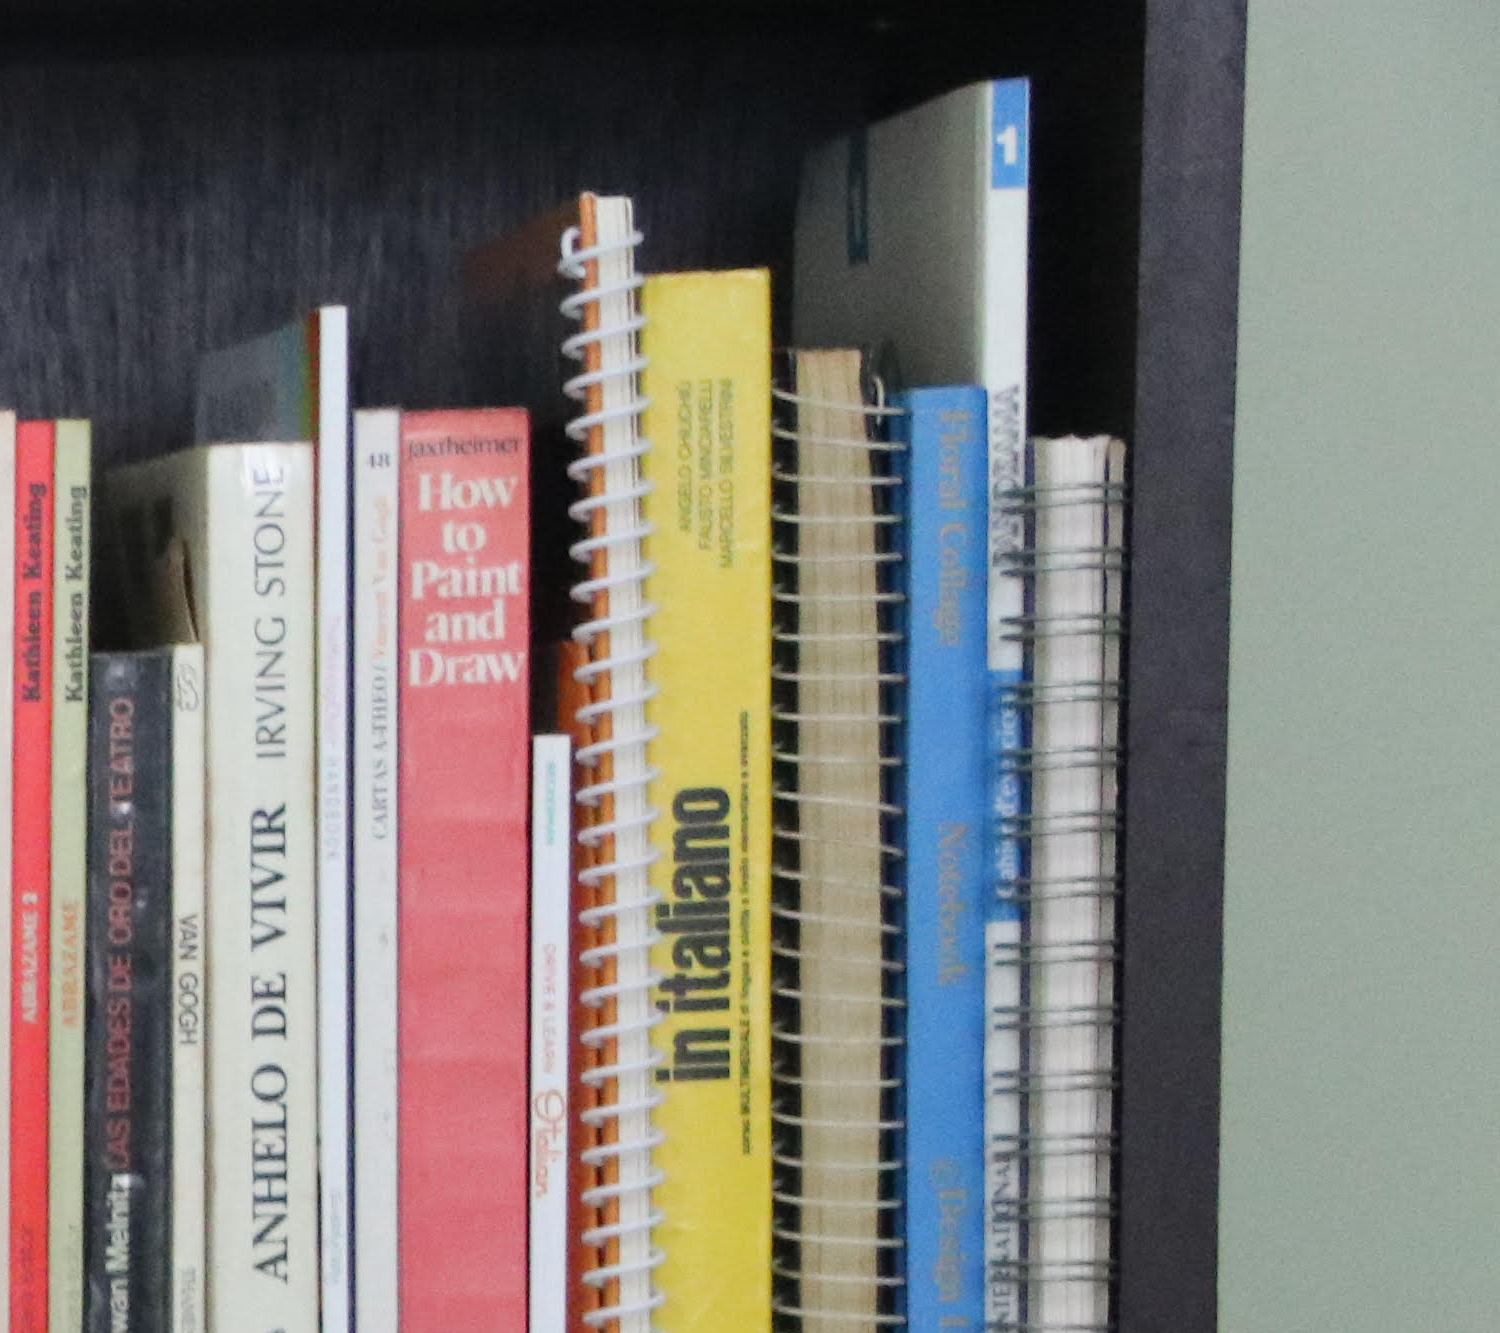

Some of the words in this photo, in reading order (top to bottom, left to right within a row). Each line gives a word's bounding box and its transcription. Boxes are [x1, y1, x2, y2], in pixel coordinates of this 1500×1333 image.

[996, 125, 1018, 165] 1
[417, 472, 519, 512] How
[23, 482, 48, 579] Keating
[65, 485, 88, 580] Keating
[252, 466, 285, 597] STONE
[440, 521, 487, 554] to
[410, 562, 523, 601] Paint
[21, 591, 43, 702] Kathleen
[64, 592, 85, 702] Kathleen
[424, 603, 506, 642] and
[254, 616, 286, 759] IRVING
[408, 650, 526, 688] Draw
[250, 803, 287, 951] VIVIR
[654, 785, 732, 1013] italiano
[179, 914, 199, 961] VAN
[178, 973, 199, 1046] GOGH
[251, 972, 286, 1040] DE
[656, 1028, 731, 1083] in
[252, 1064, 288, 1285] ANHELO
